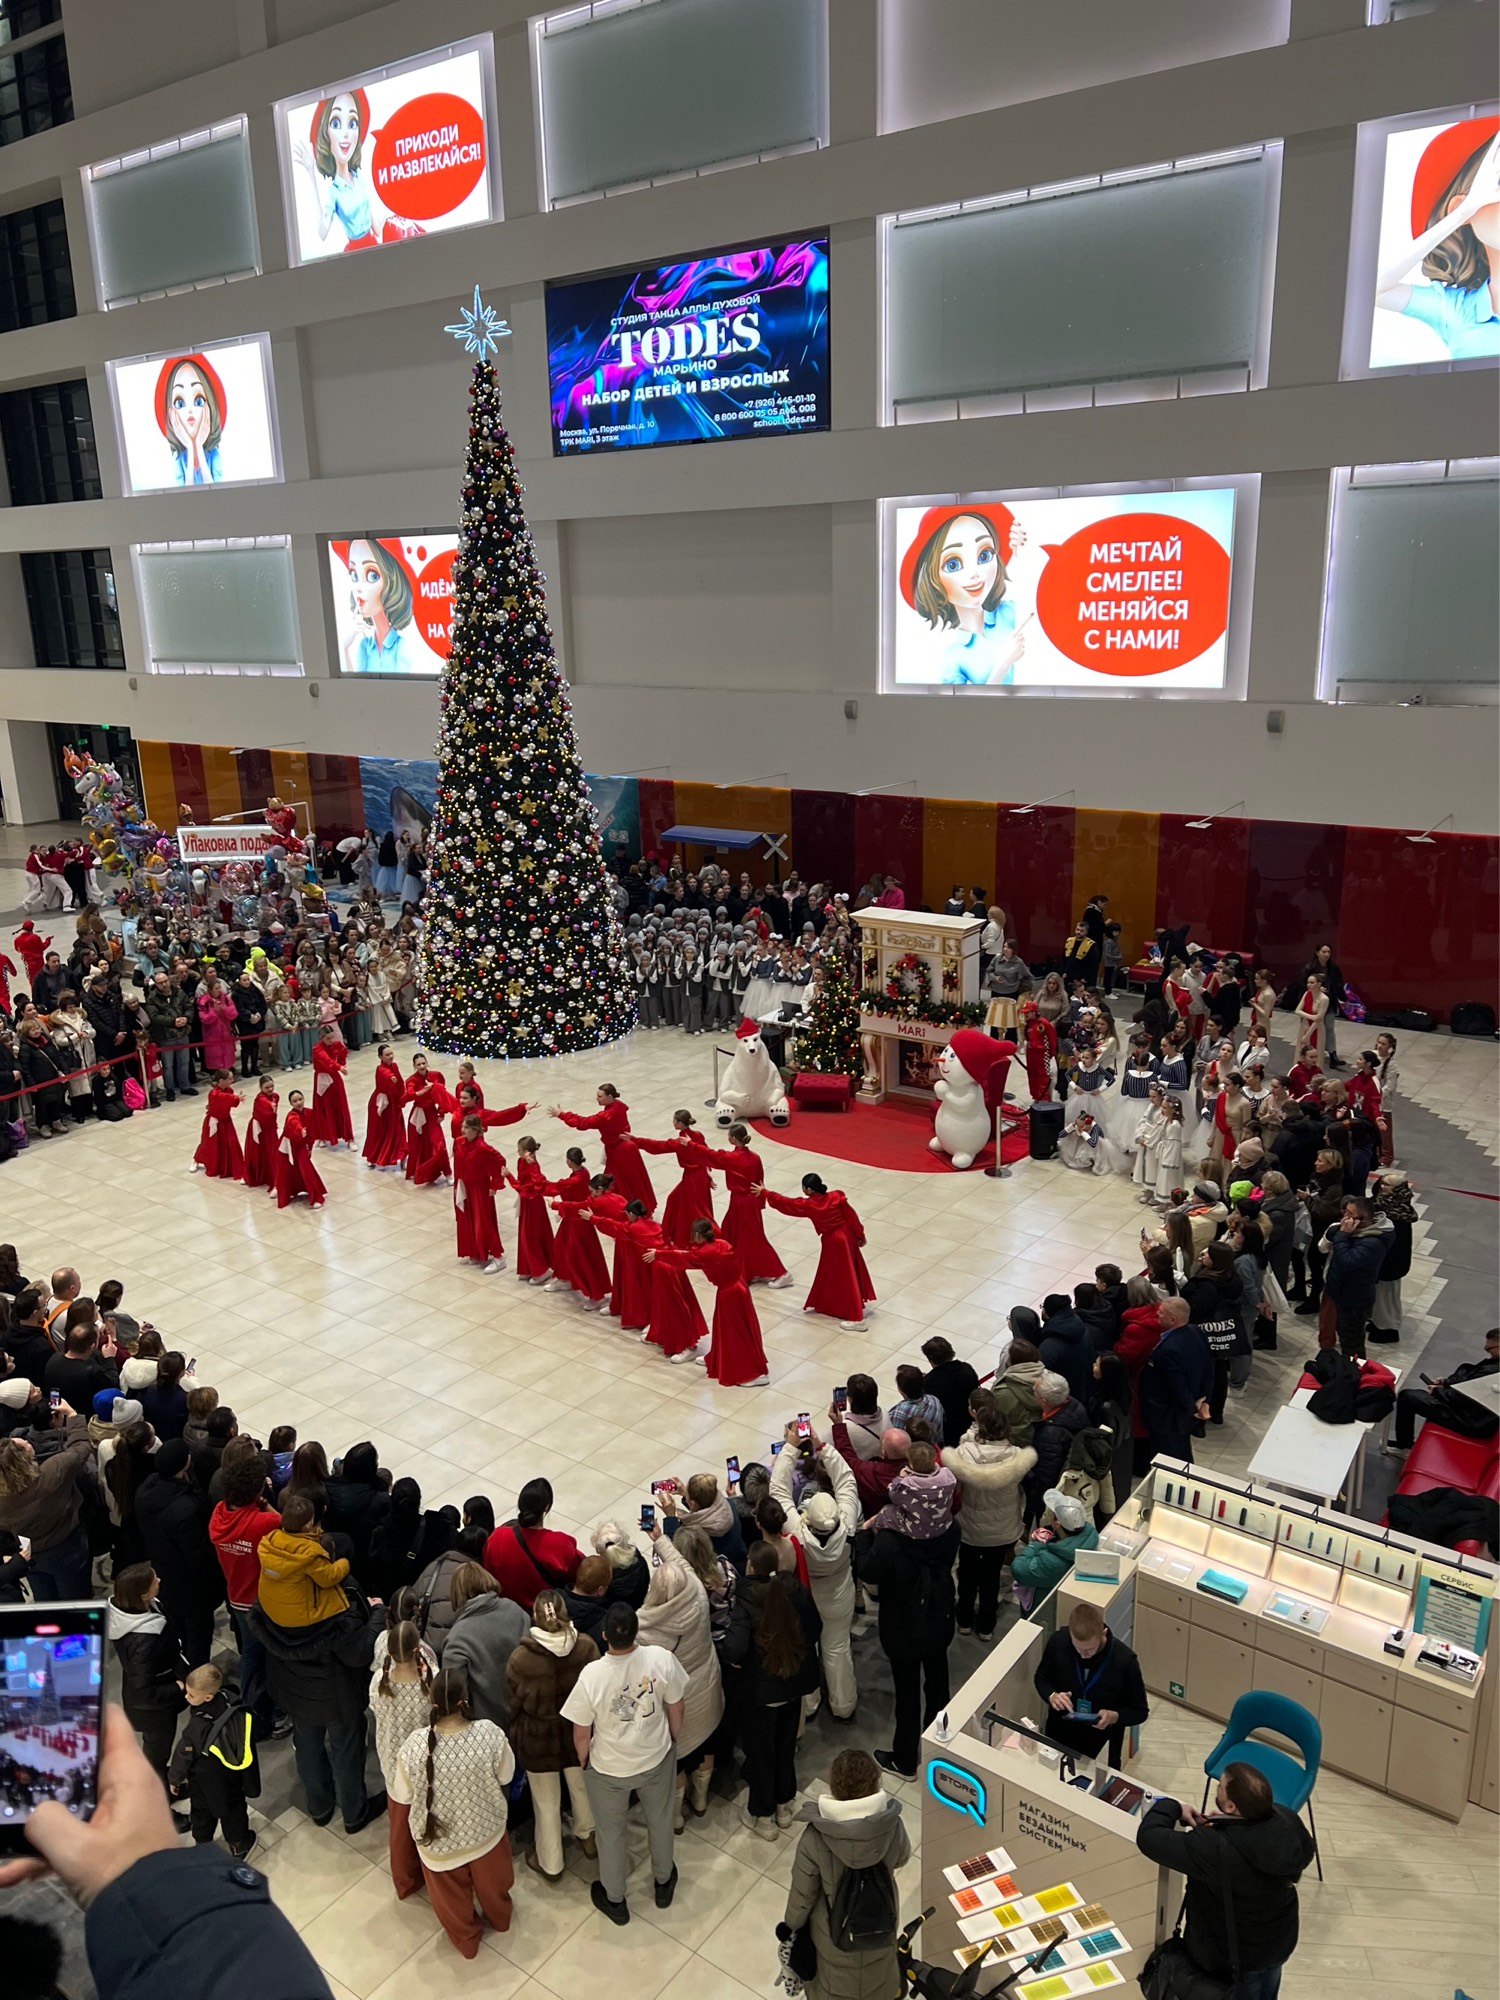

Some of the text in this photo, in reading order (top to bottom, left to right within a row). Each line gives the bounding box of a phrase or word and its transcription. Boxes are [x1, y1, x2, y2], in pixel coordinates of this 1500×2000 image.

[395, 123, 459, 157] ПРИХОДИ
[378, 142, 481, 185] И РАЗВЛЕКАЙСЯ!
[610, 293, 761, 326] СТУДИЯ ТАНЦА АЛЛЫ ДУХОВОЙ
[611, 312, 761, 368] TODES
[653, 359, 717, 377] МАРЬИНО
[581, 369, 790, 406] НАБОР ДЕТЕЙ И ВЗРОСЛЫХ
[744, 393, 816, 408] +7 (926) 445-01-10
[714, 413, 720, 422] 8
[721, 412, 737, 421] 800
[738, 411, 754, 419] 600
[755, 409, 766, 417] 05
[767, 407, 778, 416] 05
[798, 403, 816, 412] 008
[753, 414, 816, 428] school.todes.ru
[560, 428, 588, 437] Москва,
[600, 423, 638, 434] Поречная,
[646, 420, 655, 428] 10
[560, 438, 575, 446] ТРК
[601, 434, 620, 442] этаж
[1090, 535, 1182, 564] МЕЧТАЙ
[1086, 570, 1183, 593] СМЕЛЕЕ!
[1078, 596, 1189, 621] МЕНЯЙСЯ
[427, 623, 446, 638] НА
[1084, 628, 1180, 650] С НАМИ!
[182, 835, 238, 852] Упаковка
[898, 1023, 926, 1038] MARi
[1198, 1318, 1236, 1333] TODES
[1440, 1574, 1474, 1590] СЕРВИС
[940, 1773, 977, 1797] STORE
[1019, 1800, 1070, 1832] МАГАЗИН
[1019, 1812, 1087, 1852] БЕЗДЫМНЫХ
[1019, 1824, 1063, 1852] СИСТЕМ
